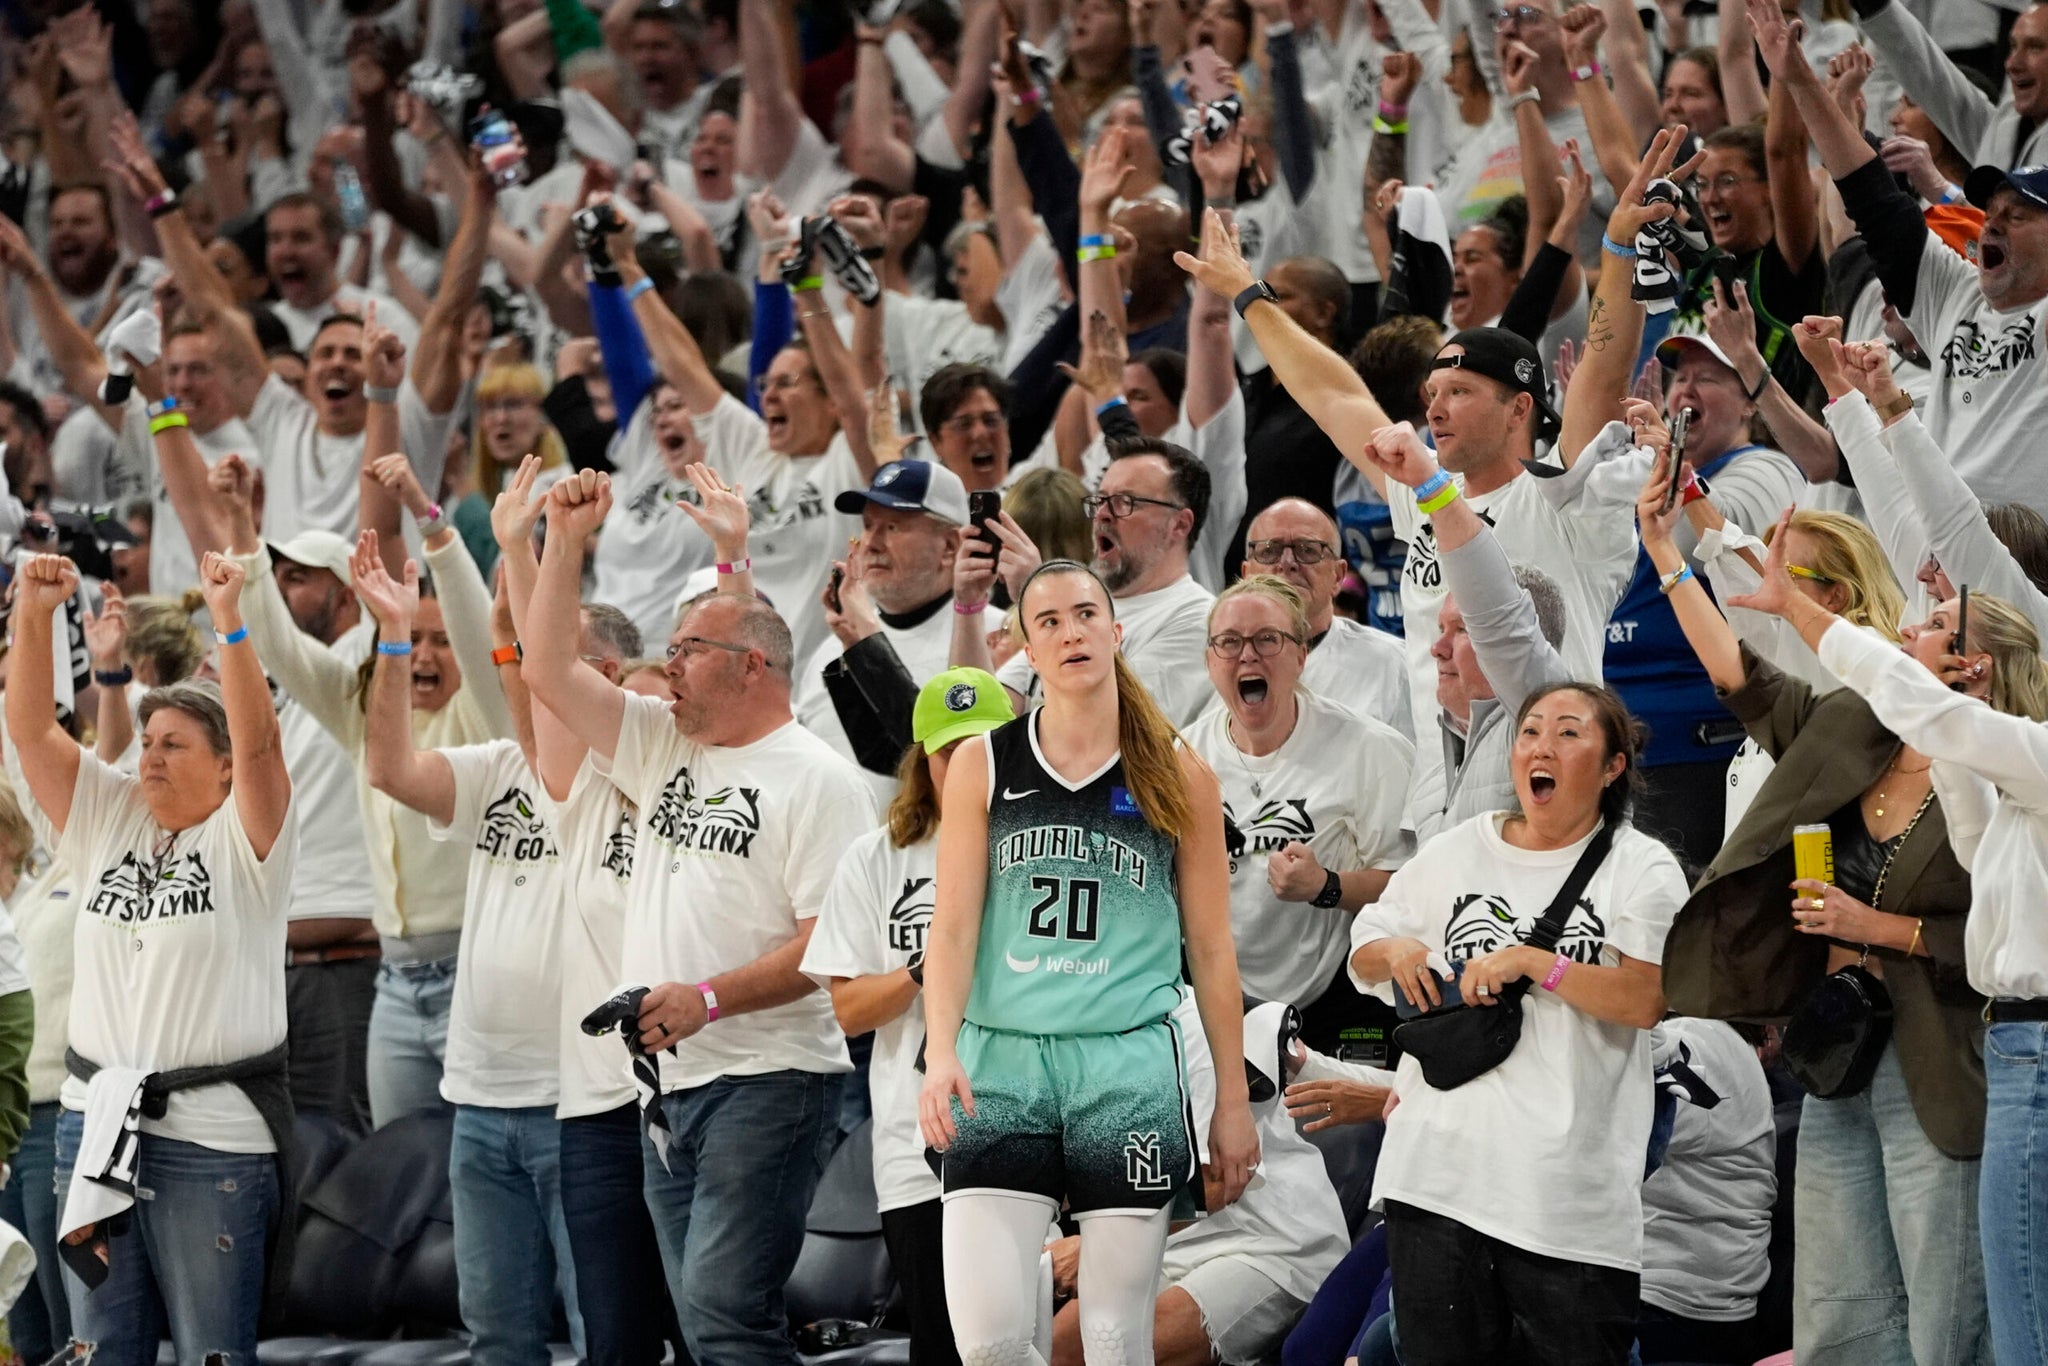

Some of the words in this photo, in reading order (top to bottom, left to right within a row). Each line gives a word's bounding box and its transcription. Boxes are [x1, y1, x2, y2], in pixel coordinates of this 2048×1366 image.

[514, 836, 545, 862] GO
[699, 824, 757, 859] LYNX
[158, 886, 215, 918] LYNX
[1027, 875, 1102, 943] 20
[1046, 955, 1110, 976] Webull
